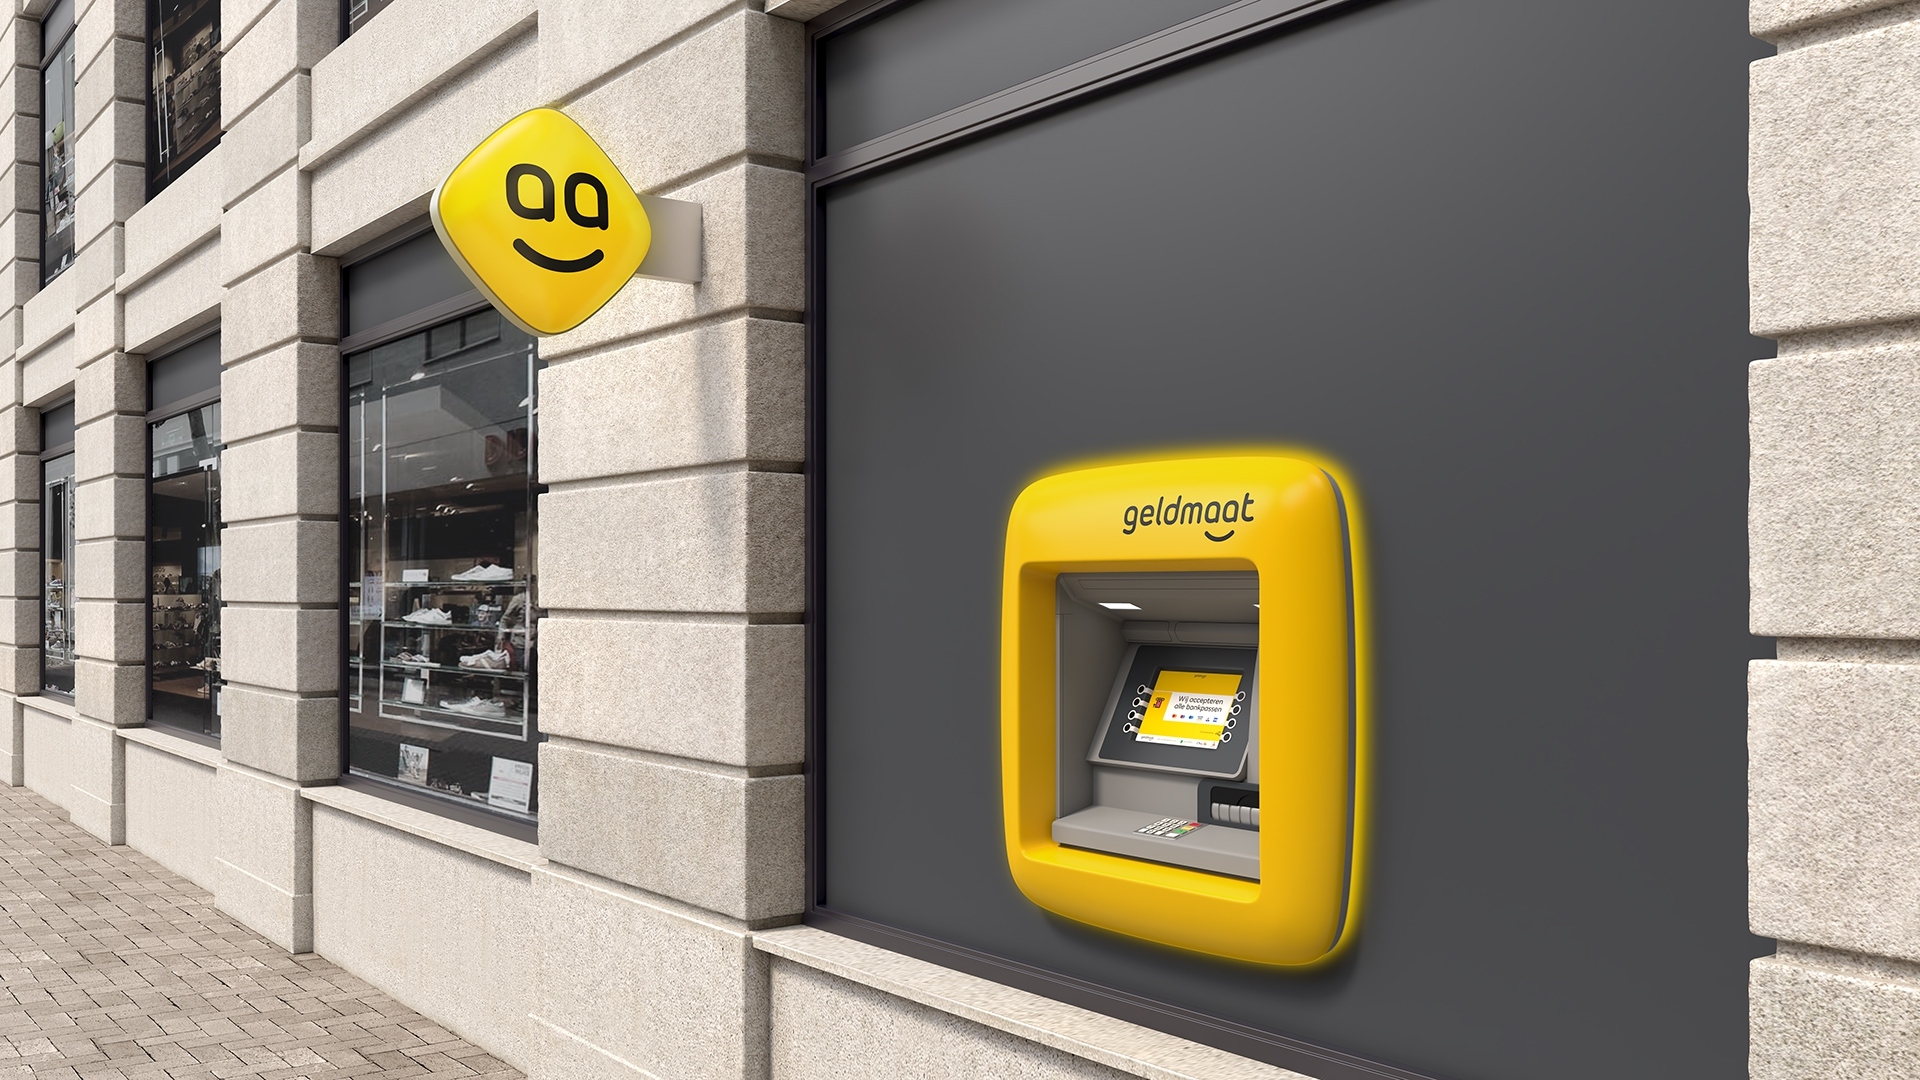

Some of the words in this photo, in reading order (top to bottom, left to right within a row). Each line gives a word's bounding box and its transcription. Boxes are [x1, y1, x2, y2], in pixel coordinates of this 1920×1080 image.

[506, 163, 608, 230] aa
[1122, 492, 1255, 535] geldmaat
[1178, 695, 1189, 704] Wij
[1189, 697, 1224, 706] accepteren
[1185, 704, 1222, 713] bankpassen
